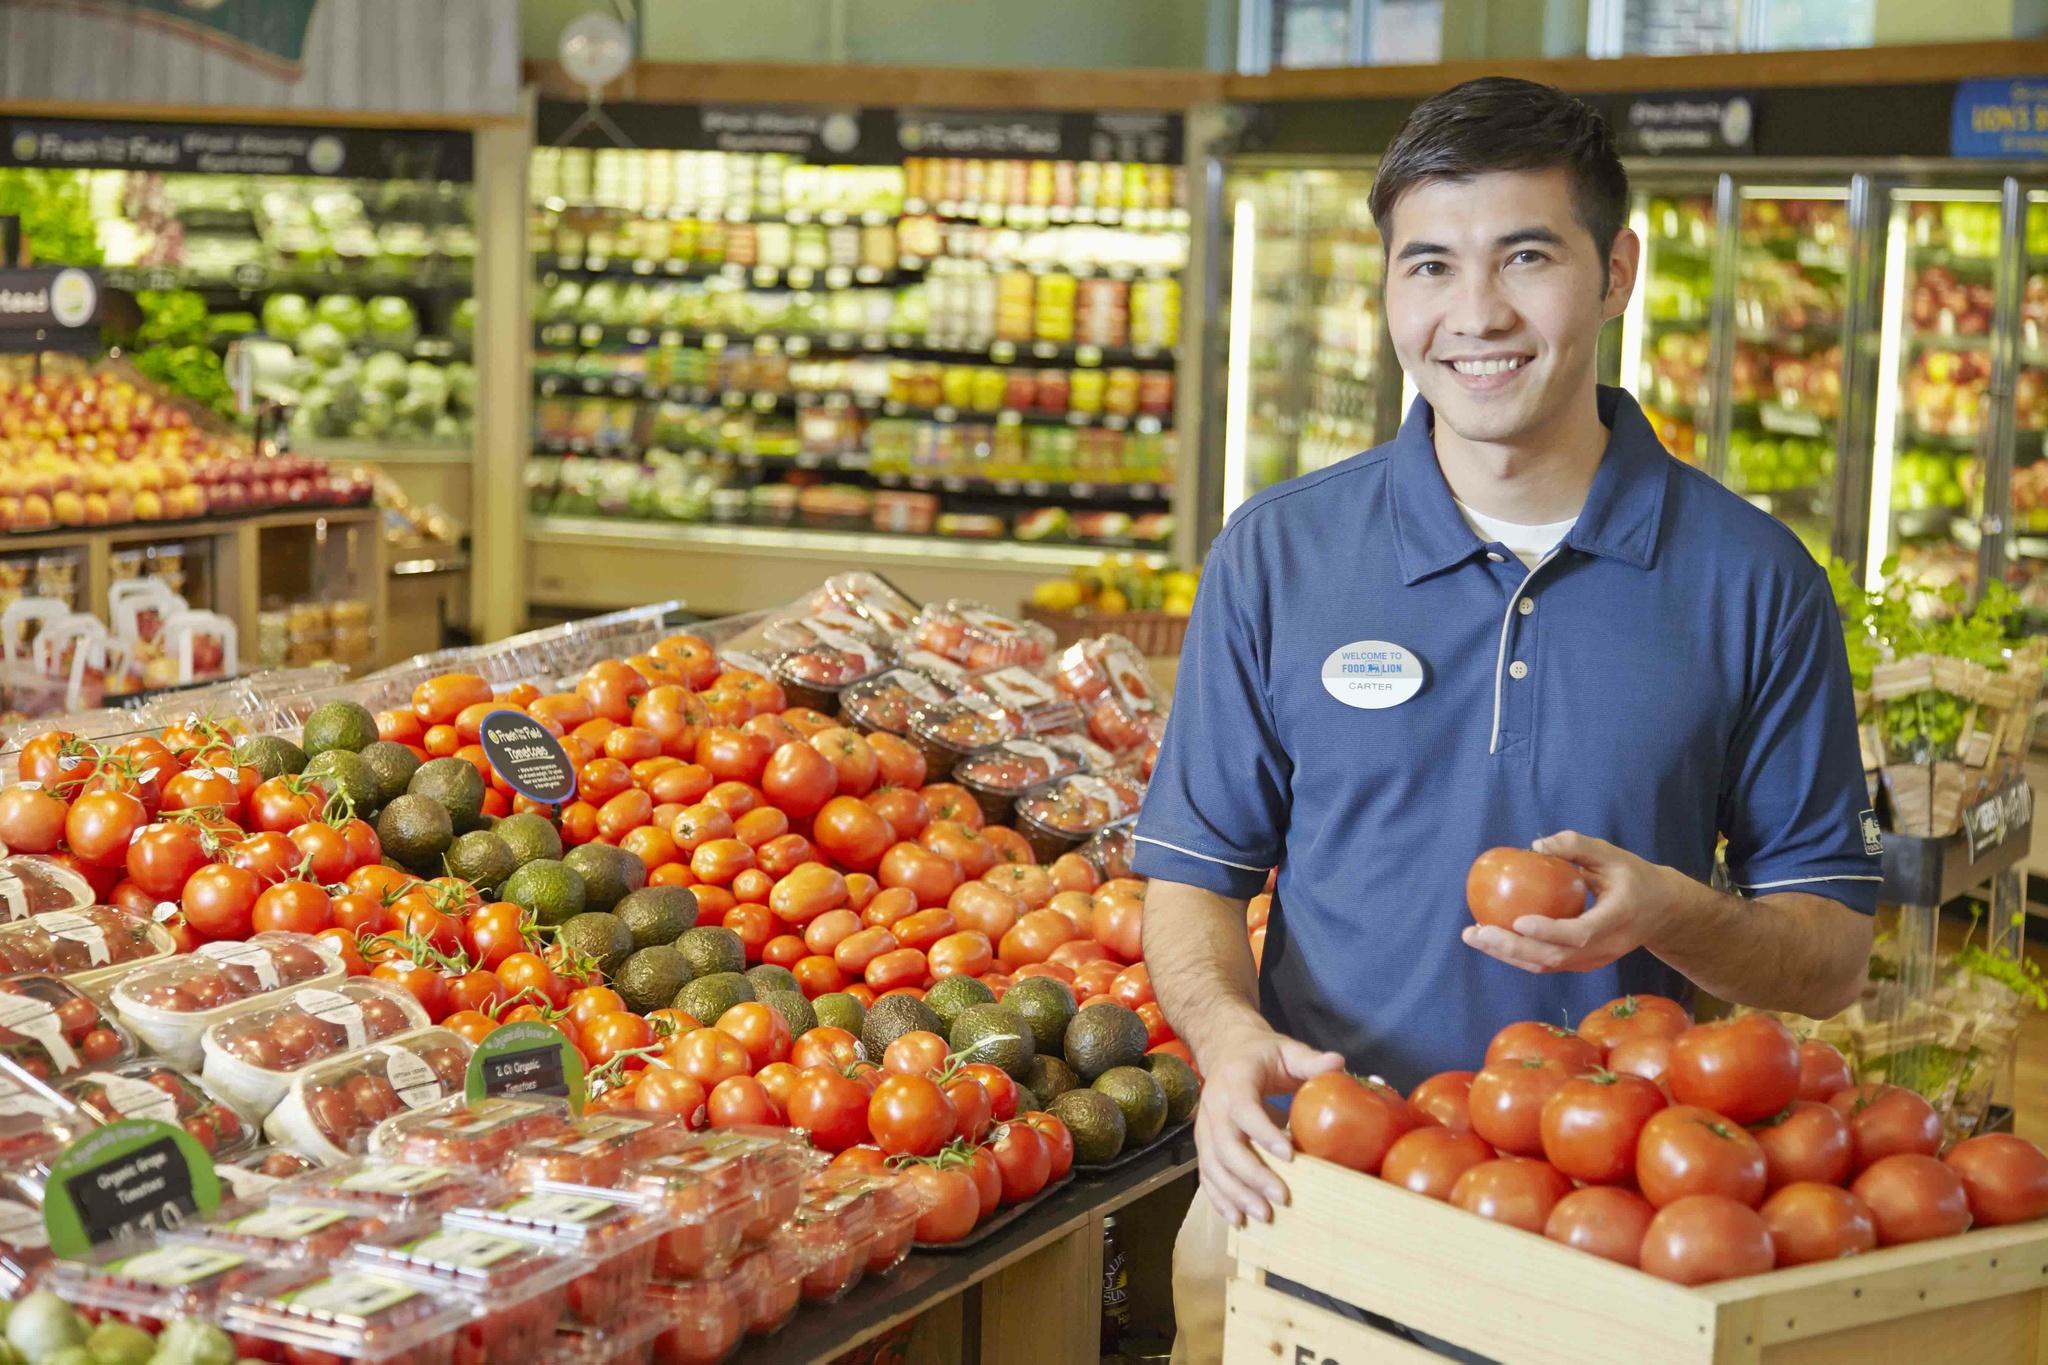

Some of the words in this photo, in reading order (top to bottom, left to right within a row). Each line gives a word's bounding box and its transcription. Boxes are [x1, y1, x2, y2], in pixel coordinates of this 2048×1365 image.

[1342, 652, 1387, 660] WELCOME
[1390, 652, 1402, 660] TO
[1342, 664, 1365, 673] FOOD
[1382, 664, 1402, 673] LION
[1349, 682, 1392, 690] CARTER
[504, 745, 548, 761] Tomatoes
[514, 1060, 541, 1075] Organic
[505, 1080, 537, 1094] Tomatoes
[97, 1164, 138, 1190] Organic
[117, 1176, 166, 1206] Tomatoes
